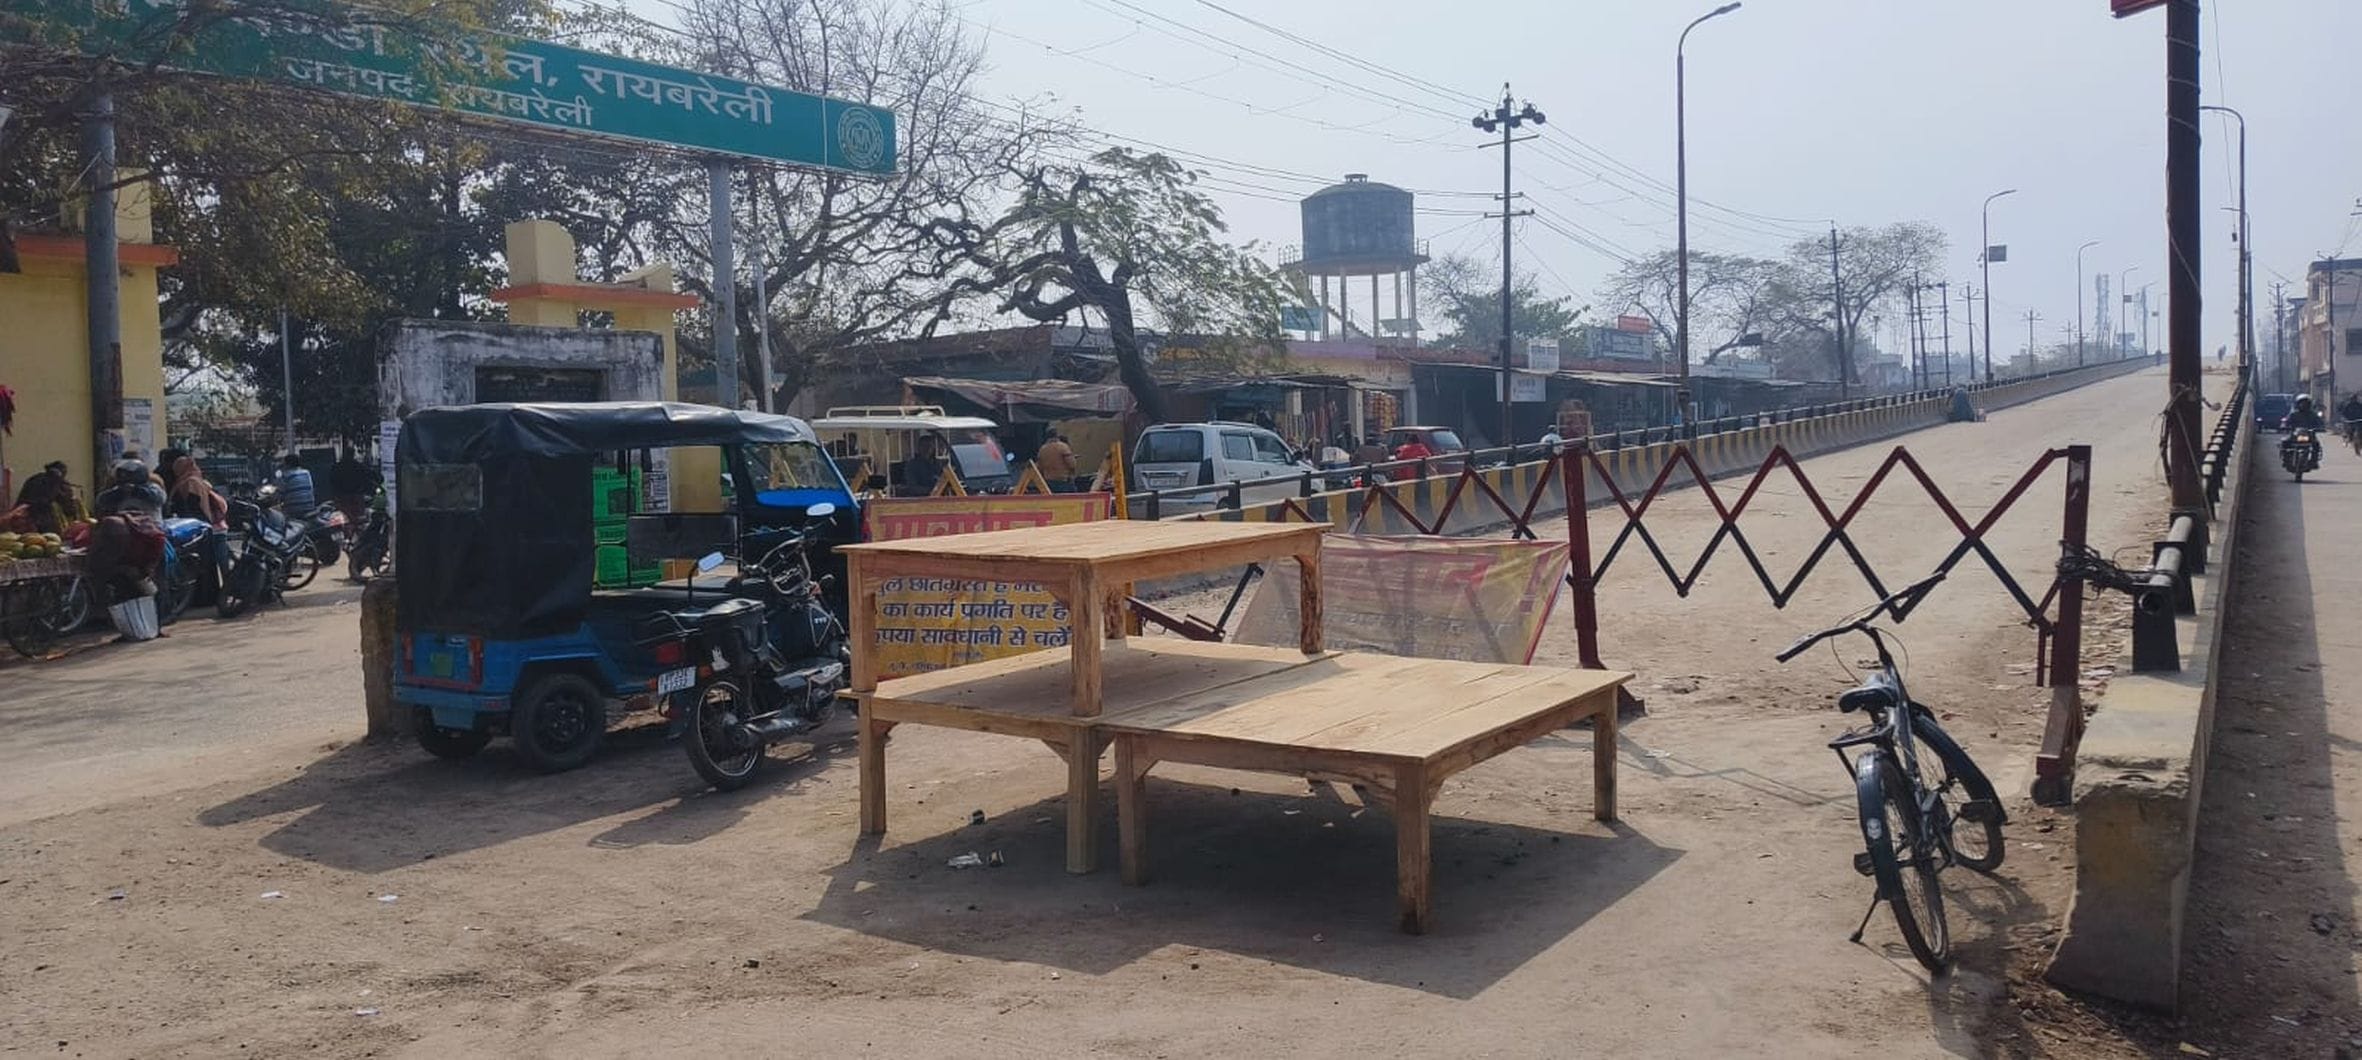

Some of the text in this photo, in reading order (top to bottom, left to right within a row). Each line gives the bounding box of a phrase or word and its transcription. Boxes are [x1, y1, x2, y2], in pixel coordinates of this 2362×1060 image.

[446, 81, 594, 126] रायबरेली
[578, 64, 774, 125] रायबरेली
[882, 602, 908, 618] का
[912, 598, 955, 618] कार्य
[961, 598, 1014, 620] प्रगति
[1021, 602, 1047, 619] पर
[921, 624, 1003, 646] सावधानी
[1008, 625, 1028, 646] से
